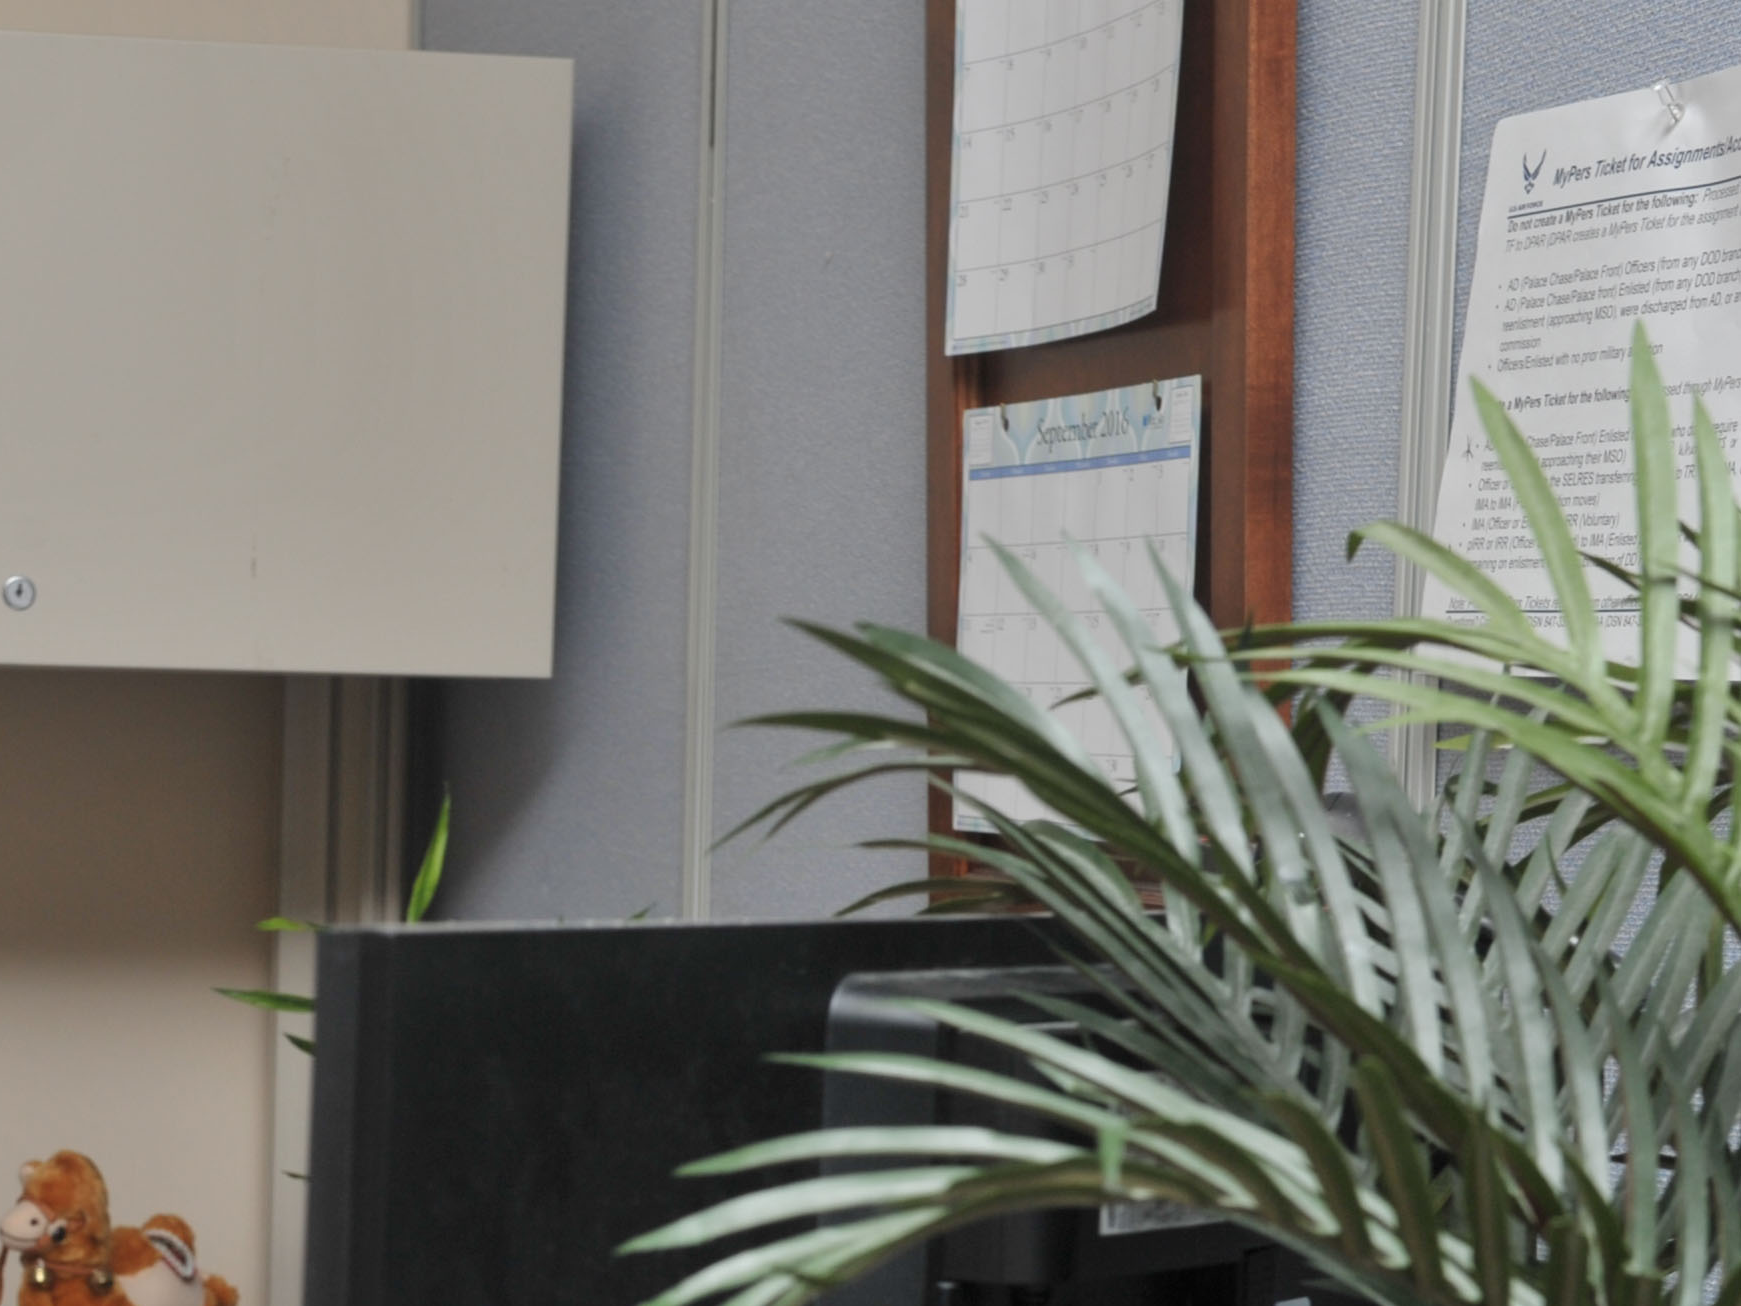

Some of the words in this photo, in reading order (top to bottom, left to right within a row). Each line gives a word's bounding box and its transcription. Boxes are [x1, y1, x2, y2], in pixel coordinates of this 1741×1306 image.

[1553, 165, 1592, 189] MyPers
[1595, 156, 1628, 179] Ticket
[1628, 153, 1647, 172] for
[1520, 218, 1533, 231] not
[1533, 214, 1558, 229] create
[1565, 208, 1594, 226] MyPers
[1596, 202, 1621, 218] Ticket
[1622, 199, 1635, 214] for
[1636, 197, 1650, 212] the
[1651, 191, 1698, 209] following:
[1608, 219, 1638, 240] MyPers
[1640, 214, 1666, 232] Ticket
[1667, 212, 1680, 228] for
[1680, 211, 1696, 227] the
[1625, 259, 1656, 275] Officers
[1681, 256, 1699, 272] any
[1618, 280, 1650, 297] Enlisted
[1676, 277, 1694, 293] any
[1620, 304, 1639, 318] were
[1640, 299, 1688, 316] discharged
[1689, 295, 1708, 311] from
[1499, 337, 1542, 353] commission
[1581, 351, 1599, 367] prior
[1599, 345, 1626, 363] military
[1513, 395, 1543, 413] MyPers
[1544, 393, 1567, 408] Ticket
[1567, 391, 1579, 406] for
[1579, 390, 1593, 404] the
[1037, 413, 1101, 453] September
[1101, 408, 1131, 438] 2016
